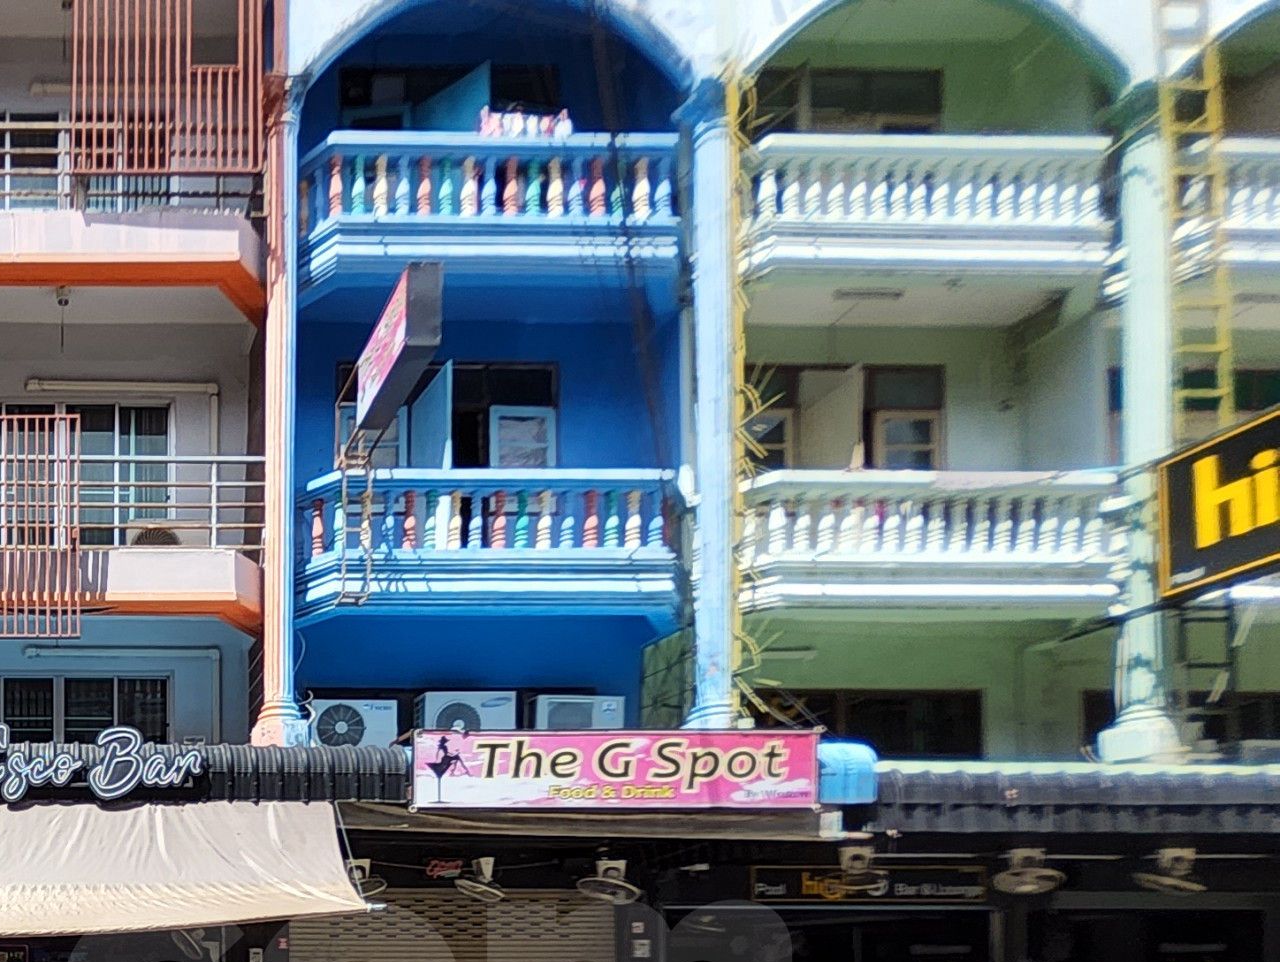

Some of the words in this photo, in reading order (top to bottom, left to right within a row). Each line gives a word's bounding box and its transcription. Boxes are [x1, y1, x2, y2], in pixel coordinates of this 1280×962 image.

[88, 725, 203, 801] Bar
[474, 736, 581, 782] The
[592, 738, 638, 781] G
[649, 738, 791, 793] Spot
[548, 783, 599, 799] Food
[601, 784, 617, 799] &
[621, 784, 677, 799] Drink
